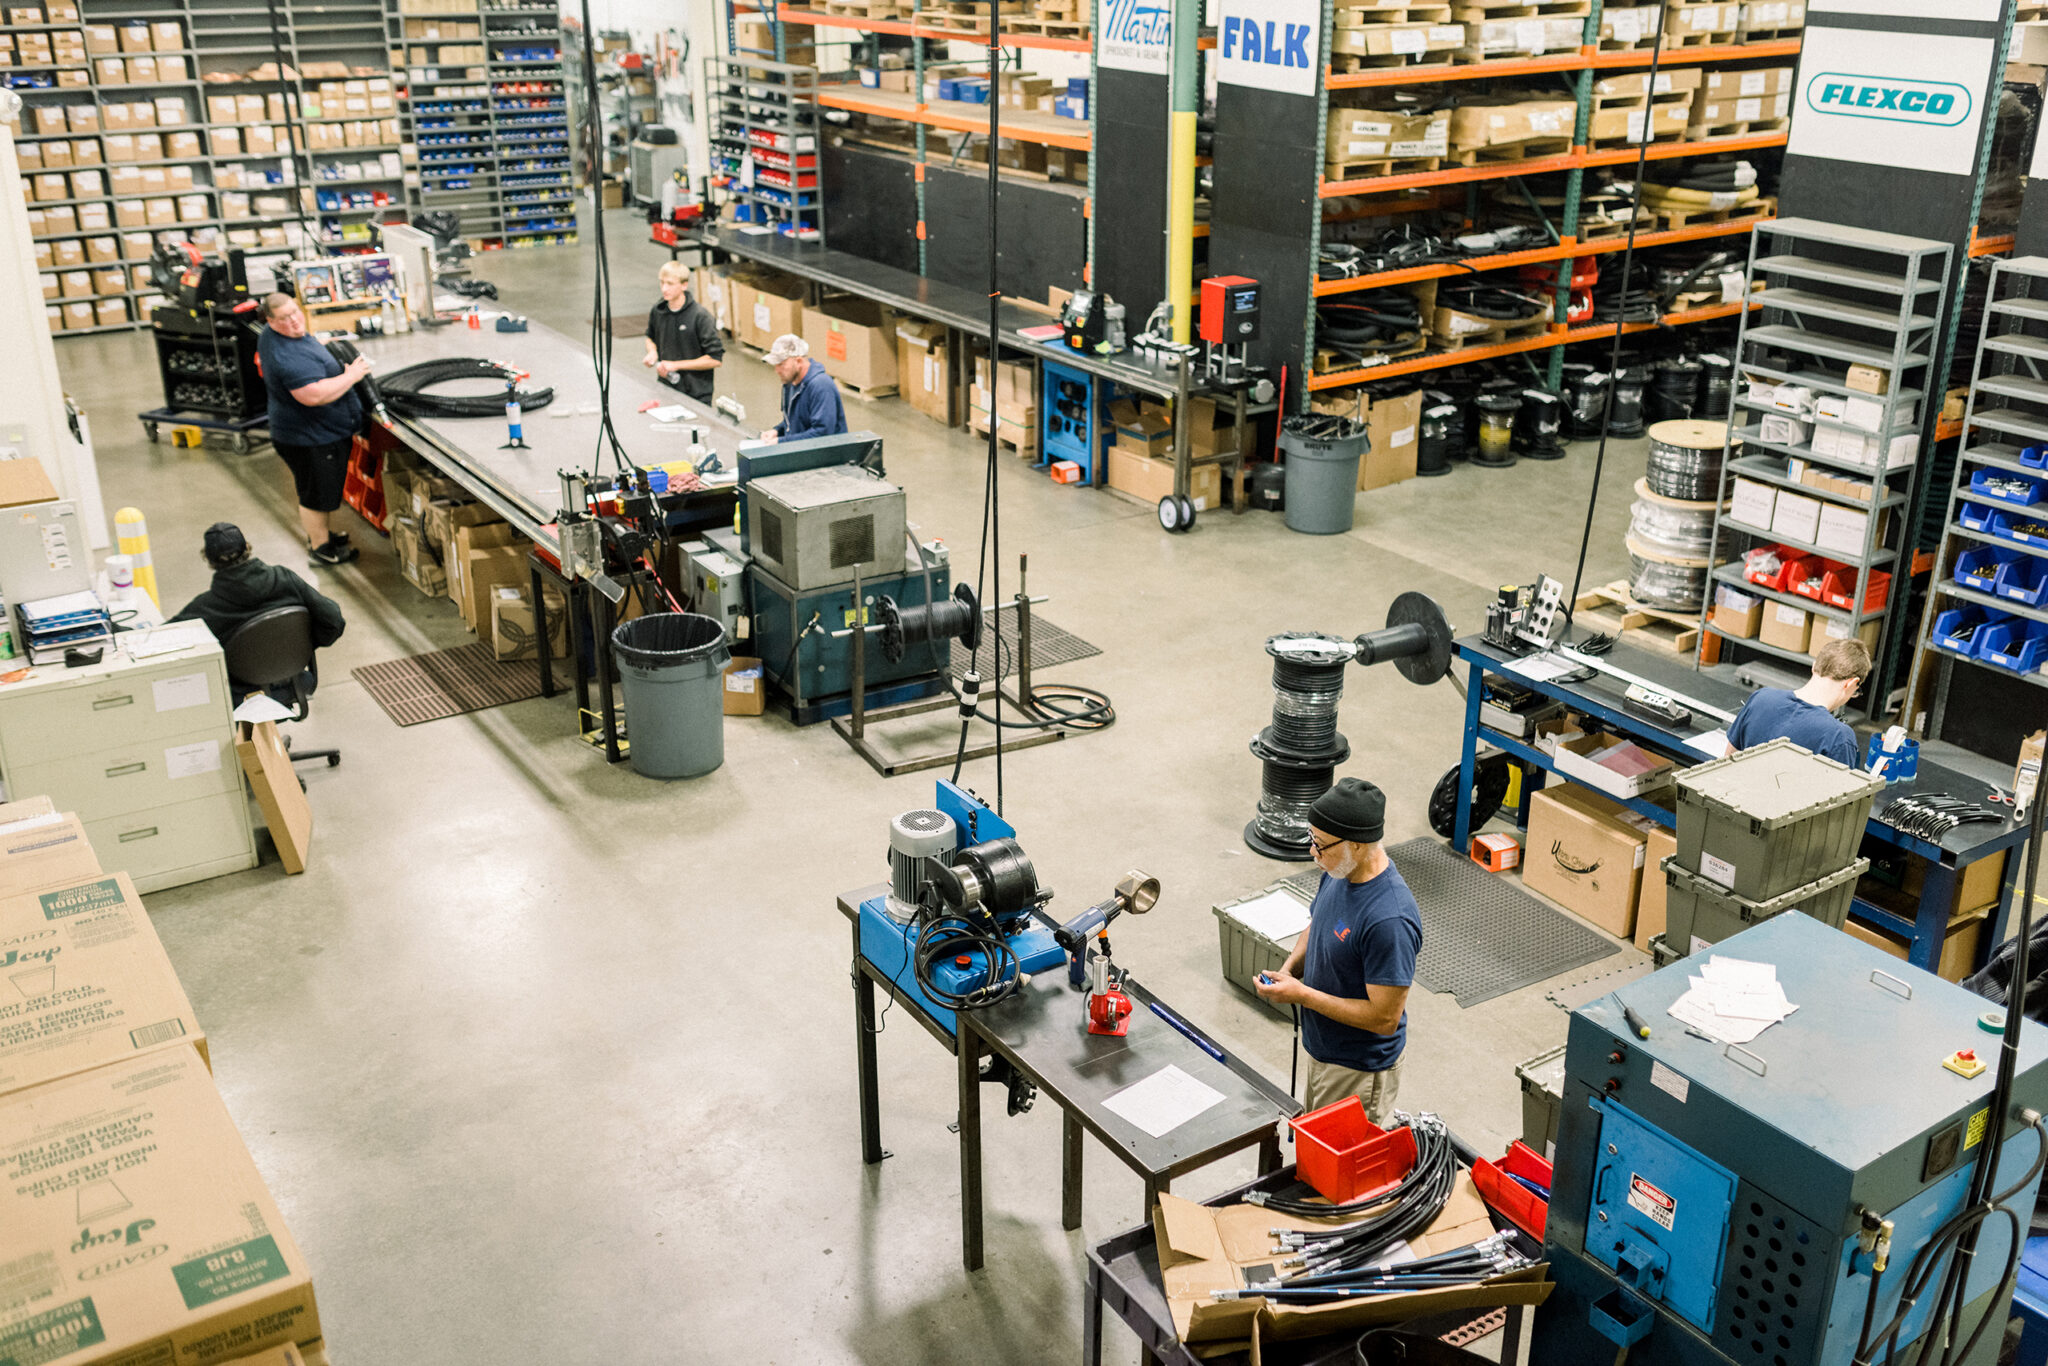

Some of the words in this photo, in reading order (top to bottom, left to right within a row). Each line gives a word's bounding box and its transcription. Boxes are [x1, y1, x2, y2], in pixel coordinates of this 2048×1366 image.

[1224, 16, 1310, 69] FALK
[1820, 83, 1955, 115] FLEXCO
[47, 895, 88, 911] 1000
[26, 996, 48, 1007] OR
[51, 984, 92, 1000] COLD
[66, 987, 106, 1003] CUPS
[40, 1008, 105, 1030] BEBIDAS
[67, 1021, 78, 1030] O
[65, 1112, 154, 1145] CALIENTES
[96, 1125, 138, 1143] PARA
[49, 1140, 61, 1150] O
[100, 1129, 154, 1150] VASOS
[19, 1140, 92, 1167] BEBIDAS
[67, 1143, 158, 1178] INSULATED
[115, 1155, 148, 1172] HOT
[16, 1174, 62, 1195] CUPS
[84, 1167, 109, 1182] OR
[33, 1177, 80, 1198] COLD
[1639, 1181, 1668, 1206] DANGER
[1652, 1209, 1671, 1224] HANDS
[1652, 1213, 1669, 1227] CLEAR
[1655, 1205, 1670, 1216] KEEP
[70, 1218, 156, 1254] Jcup
[205, 1248, 247, 1273] 8JB
[229, 1272, 265, 1289] STOCK
[35, 1315, 92, 1345] 1000
[255, 1318, 294, 1338] HANDLE
[225, 1330, 253, 1349] WITH
[196, 1341, 224, 1359] CARE
